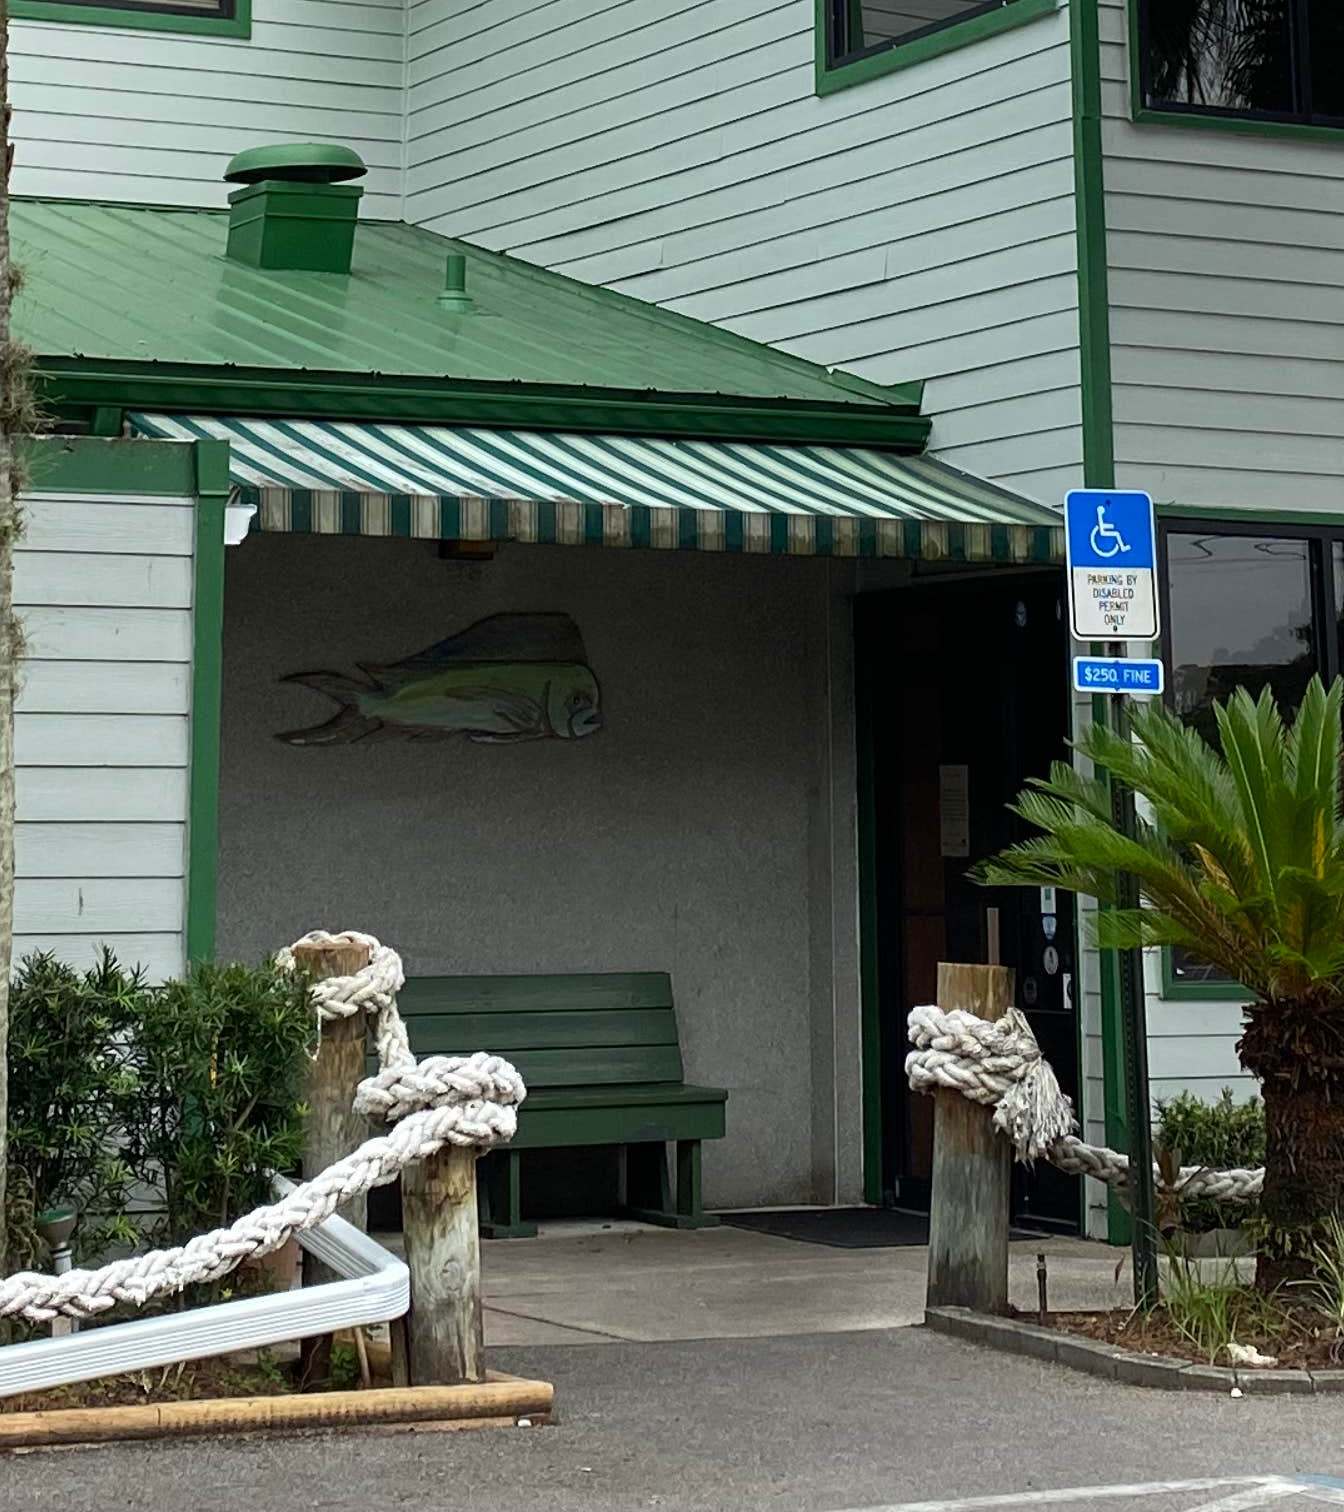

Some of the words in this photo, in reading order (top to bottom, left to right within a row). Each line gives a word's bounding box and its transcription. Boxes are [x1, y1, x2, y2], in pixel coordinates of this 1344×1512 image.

[1087, 573, 1123, 586] PARKING
[1127, 574, 1138, 586] BY
[1093, 588, 1134, 599] DISABLED
[1099, 600, 1129, 612] PERMIT
[1104, 614, 1125, 626] ONLY
[1123, 669, 1152, 684] FINE
